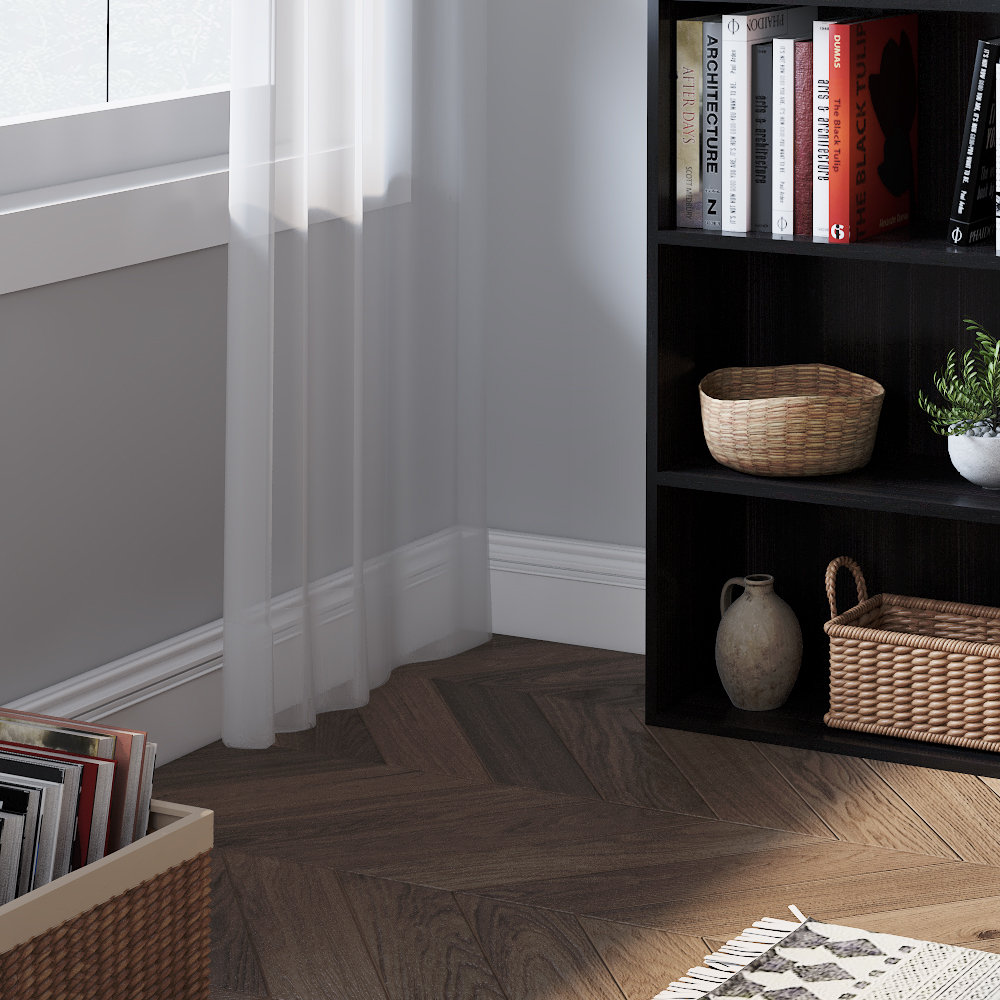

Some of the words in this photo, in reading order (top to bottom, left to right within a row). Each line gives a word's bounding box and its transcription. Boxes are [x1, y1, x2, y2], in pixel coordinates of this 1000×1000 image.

[833, 34, 841, 69] DUMAS
[855, 23, 867, 97] TULIP
[681, 66, 696, 108] AFTER
[706, 34, 718, 174] ARCHITECTURE
[755, 95, 768, 113] arts
[833, 98, 841, 112] The
[681, 111, 696, 145] DAYS
[833, 119, 841, 146] Black
[855, 102, 867, 186] BLACK
[755, 128, 770, 184] architecture
[832, 147, 842, 173] Tulip
[685, 166, 693, 187] SCOTT
[855, 191, 867, 239] THE
